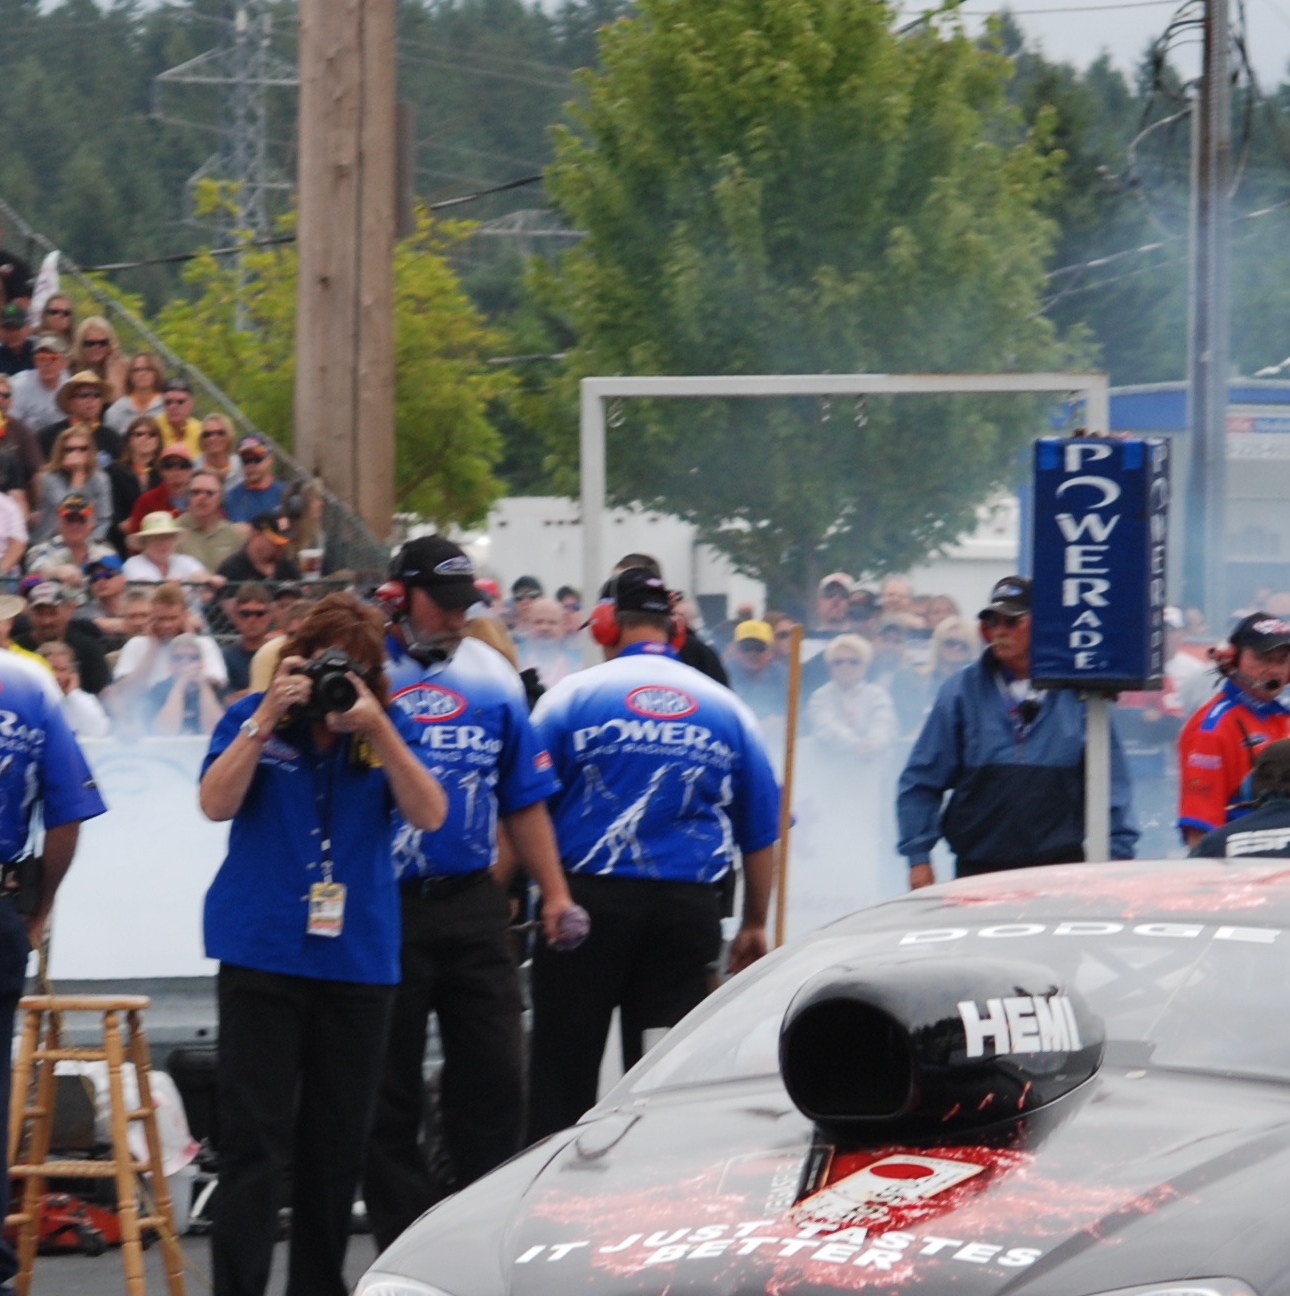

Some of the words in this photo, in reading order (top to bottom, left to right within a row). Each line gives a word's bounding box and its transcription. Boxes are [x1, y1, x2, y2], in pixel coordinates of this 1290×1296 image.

[1055, 443, 1121, 670] POWERADE
[898, 921, 1283, 946] DODGE
[957, 995, 1083, 1058] HEMI
[514, 1240, 590, 1264] IT
[599, 1219, 776, 1254] JUST
[795, 1221, 1043, 1267] TASTES
[643, 1236, 904, 1271] BETTER
